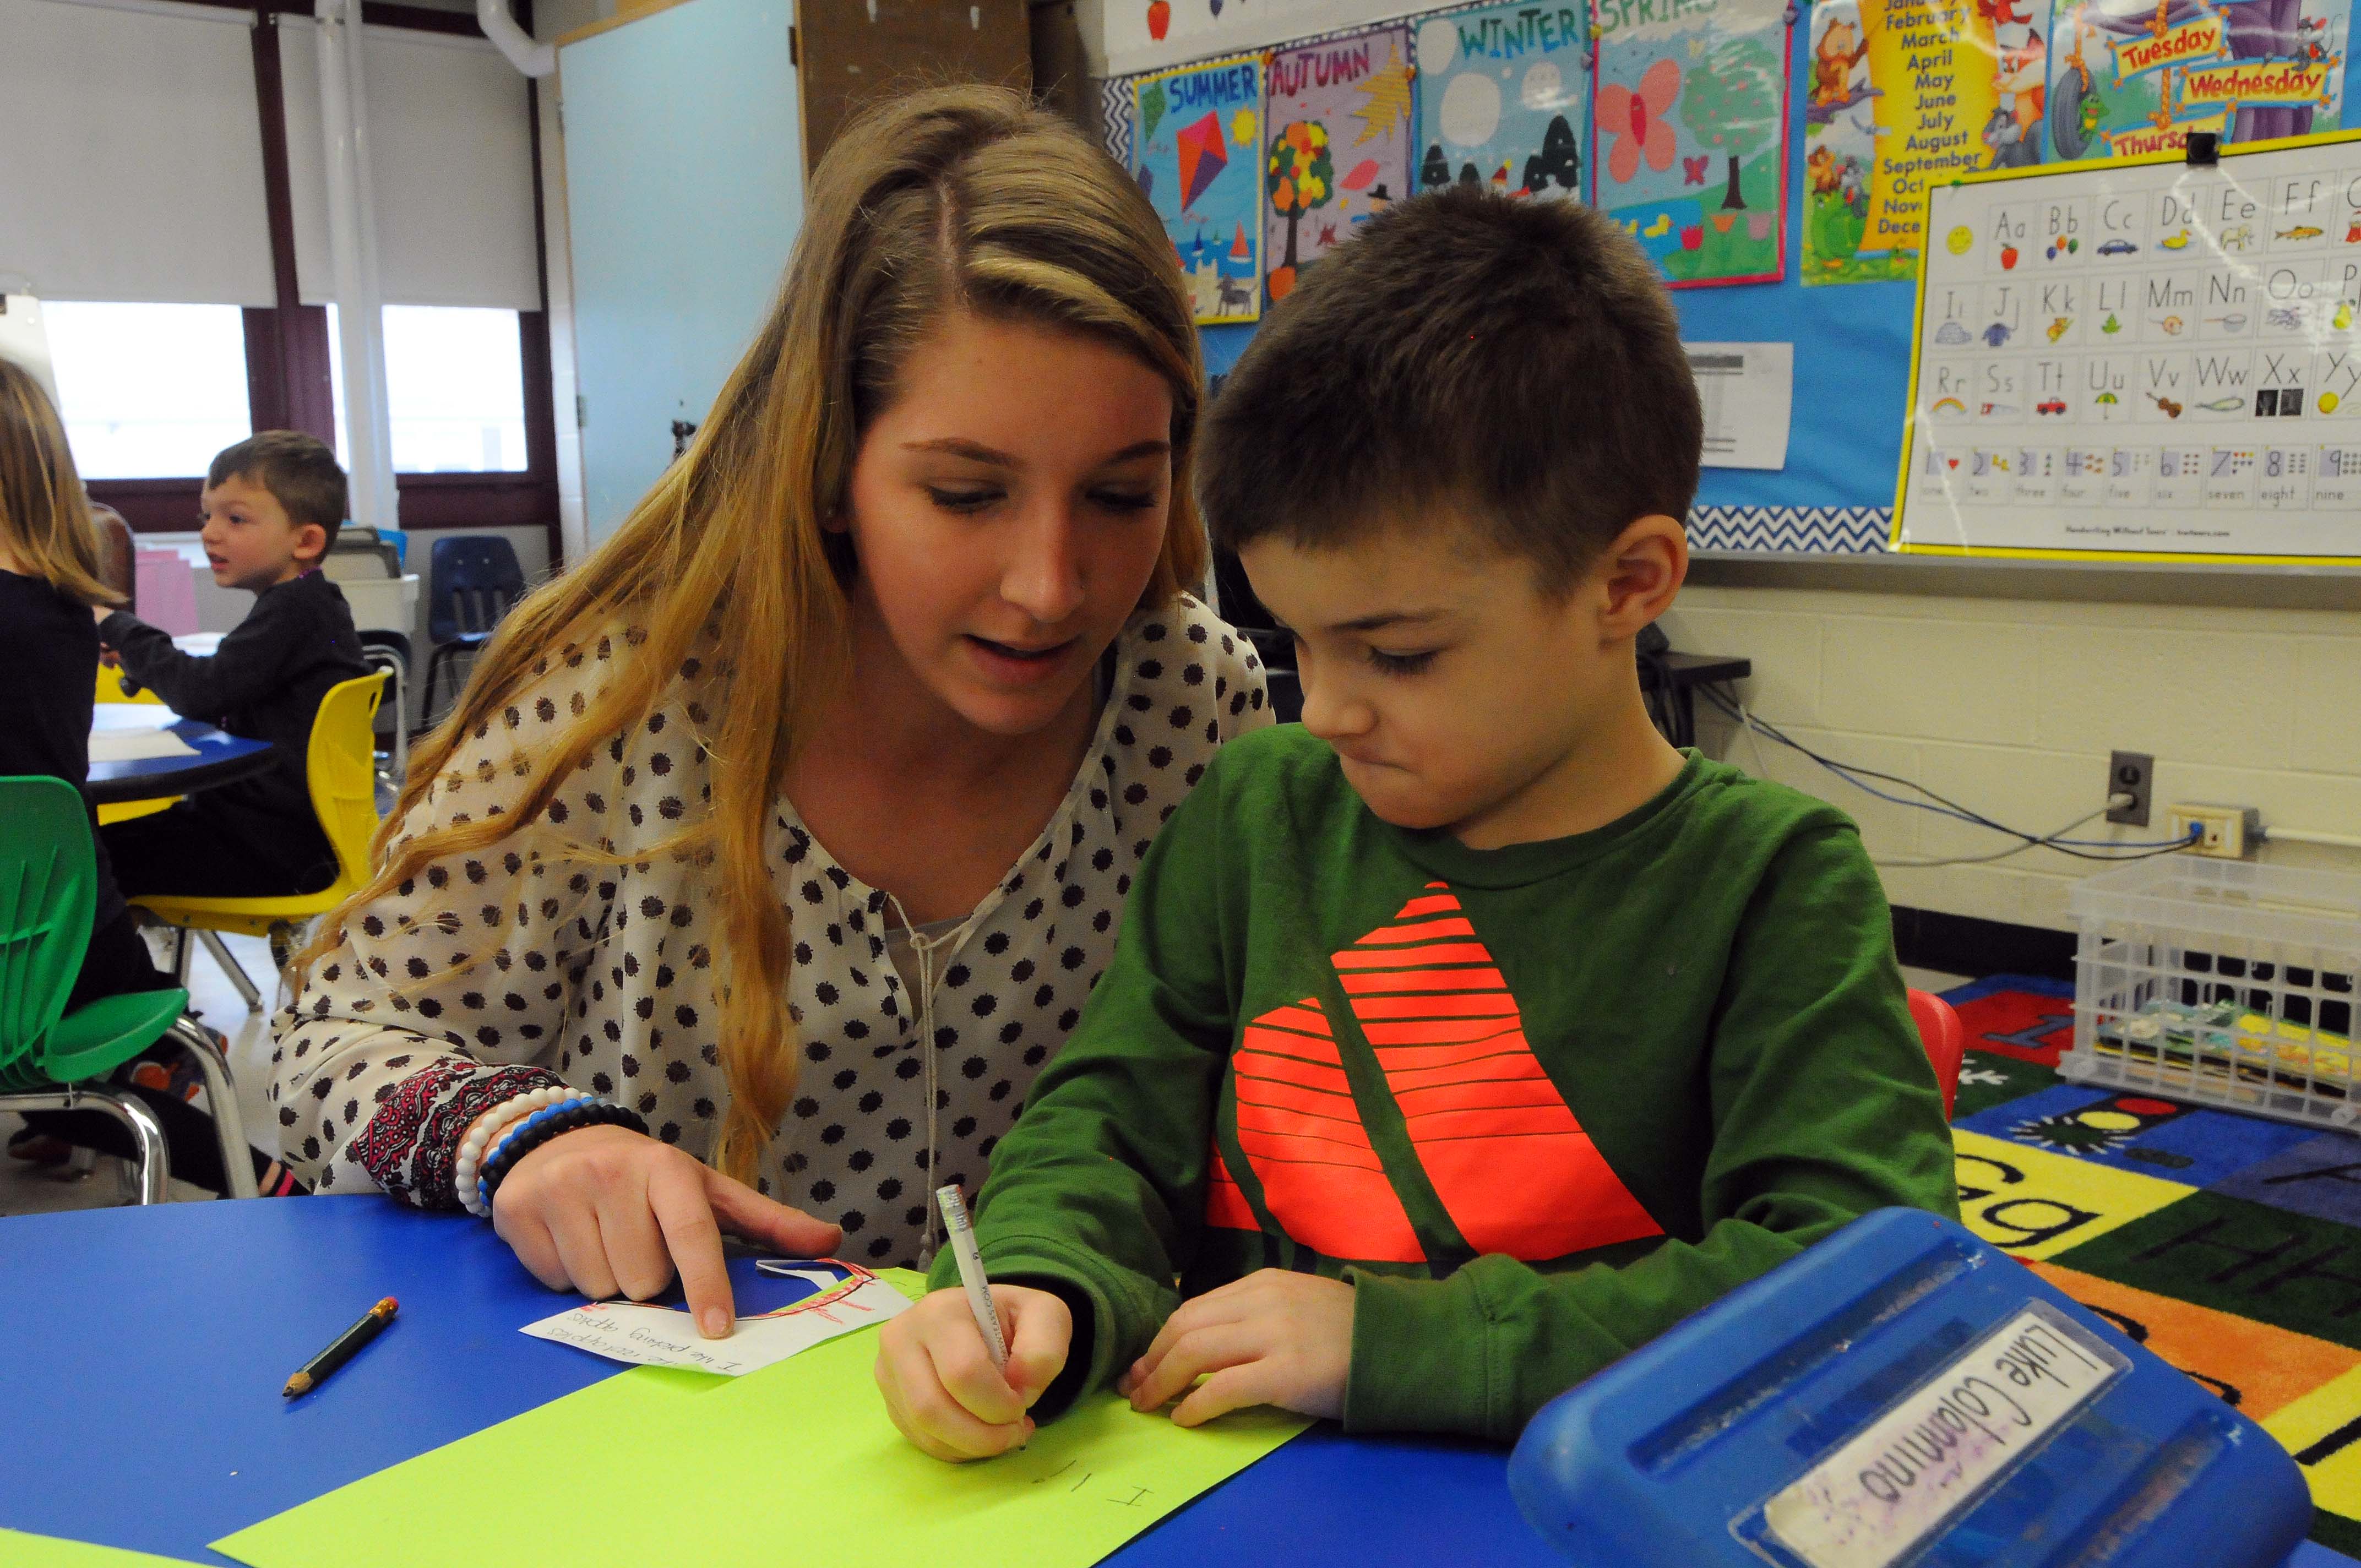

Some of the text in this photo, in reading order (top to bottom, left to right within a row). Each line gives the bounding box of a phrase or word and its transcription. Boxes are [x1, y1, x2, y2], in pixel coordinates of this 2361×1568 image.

[1885, 0, 1956, 11] Janu
[1886, 7, 1971, 31] February
[1459, 9, 1579, 59] WINTER
[1902, 26, 1960, 50] March
[1907, 49, 1953, 74] April
[2121, 28, 2217, 69] Tuesday
[1270, 43, 1370, 96] AUTUMN
[1915, 73, 1955, 92] May
[1169, 65, 1258, 114] SUMMER
[2190, 69, 2322, 99] Wednesday
[1915, 94, 1957, 110] June
[1918, 111, 1954, 132] July
[1905, 131, 1969, 153] August
[2114, 126, 2194, 156] Thursd
[1884, 151, 1982, 177] September
[1884, 199, 1923, 214] Nov
[1995, 211, 2026, 240] Aa
[2049, 205, 2079, 235] Bb
[2104, 200, 2132, 231] Cc
[2222, 189, 2256, 221] Ee
[2285, 180, 2321, 215] Ff
[2043, 284, 2074, 314] Kk
[2148, 277, 2193, 308] Mm
[2210, 273, 2246, 304] Nn
[2269, 269, 2313, 300] Oo
[2090, 360, 2125, 391] Uu
[2149, 358, 2180, 387] Vv
[2196, 356, 2249, 386] Ww
[2263, 353, 2301, 384] Xx
[2066, 451, 2083, 476] 4
[2210, 451, 2232, 477] 7
[2267, 450, 2281, 477] 8
[2260, 485, 2295, 507] eight
[2315, 491, 2344, 500] nine
[1995, 1325, 2099, 1389] Luke
